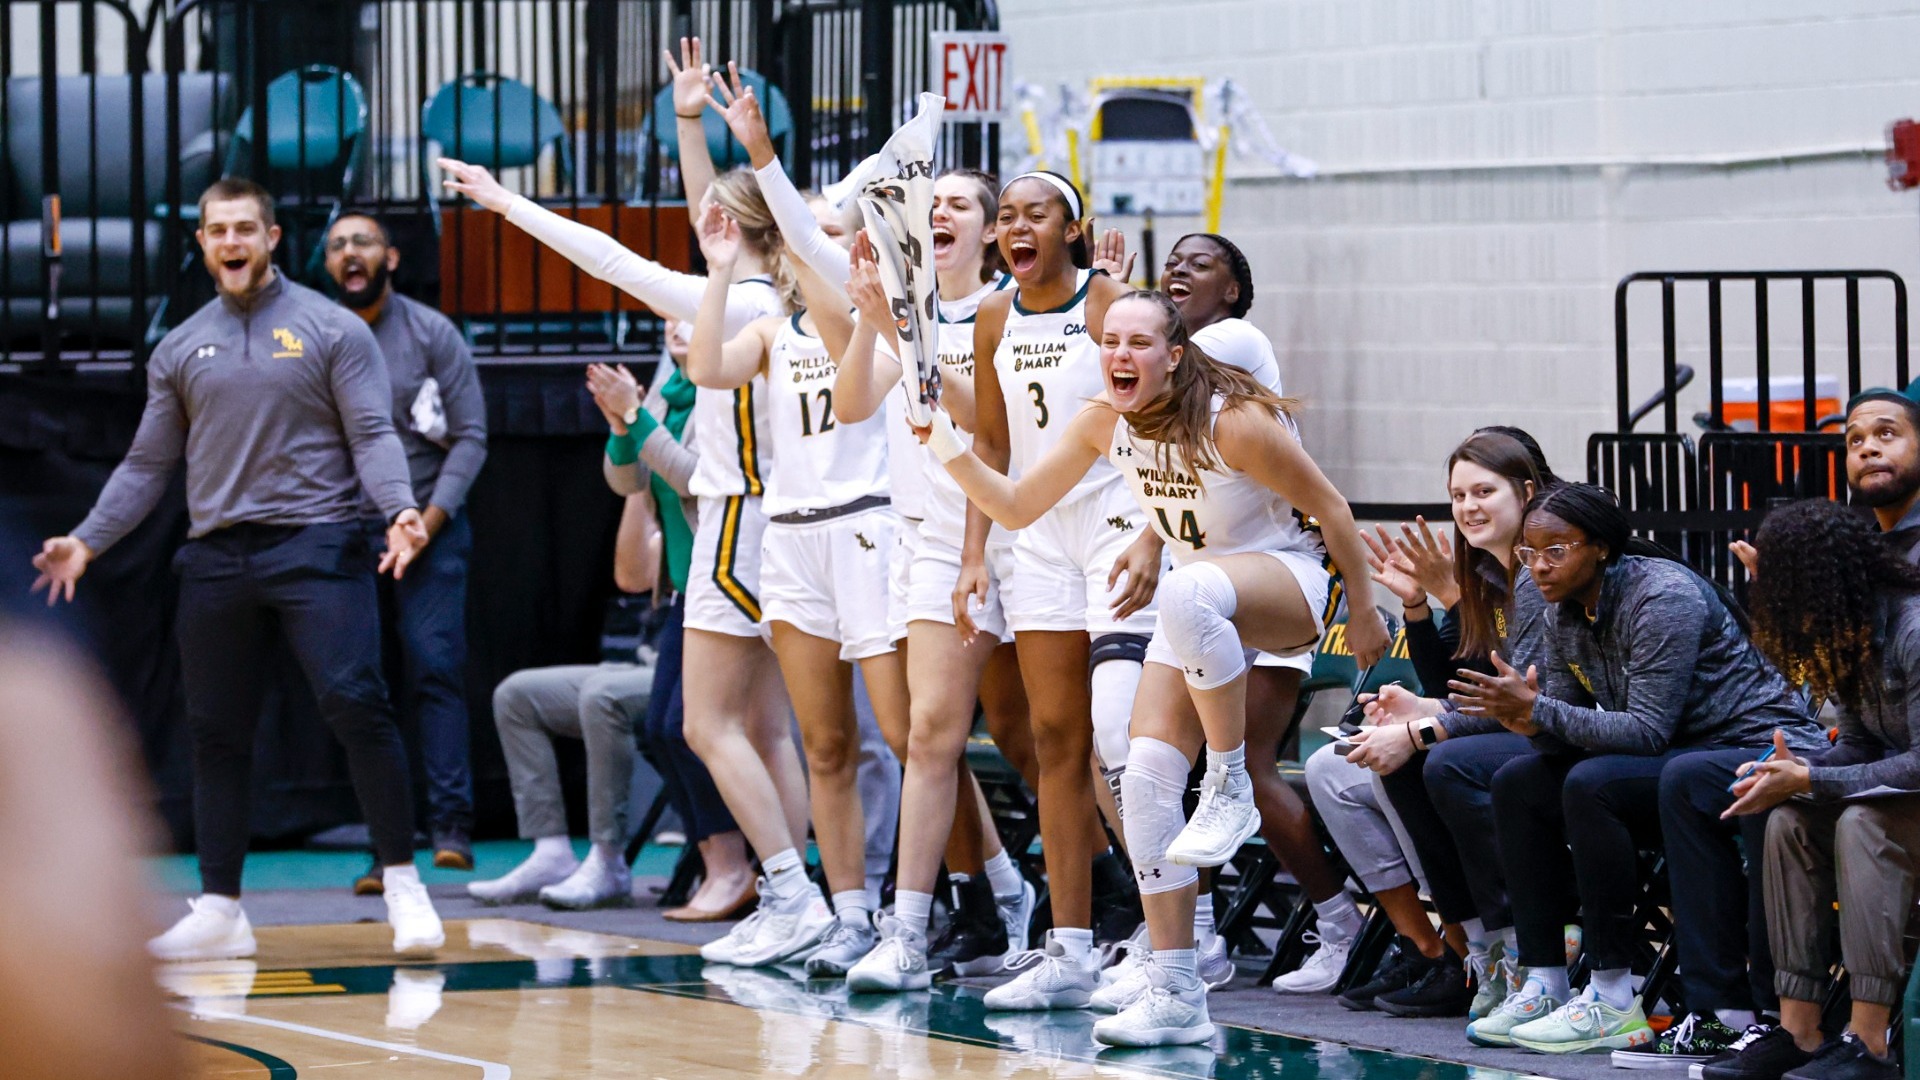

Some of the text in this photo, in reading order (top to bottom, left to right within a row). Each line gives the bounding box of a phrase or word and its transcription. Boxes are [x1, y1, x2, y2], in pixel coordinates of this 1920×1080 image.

[943, 42, 1006, 111] EXIT
[788, 356, 831, 369] WILLIA
[1012, 342, 1067, 356] WILLIAM
[798, 387, 836, 438] 12
[1027, 381, 1049, 429] 3
[1153, 506, 1206, 551] 14
